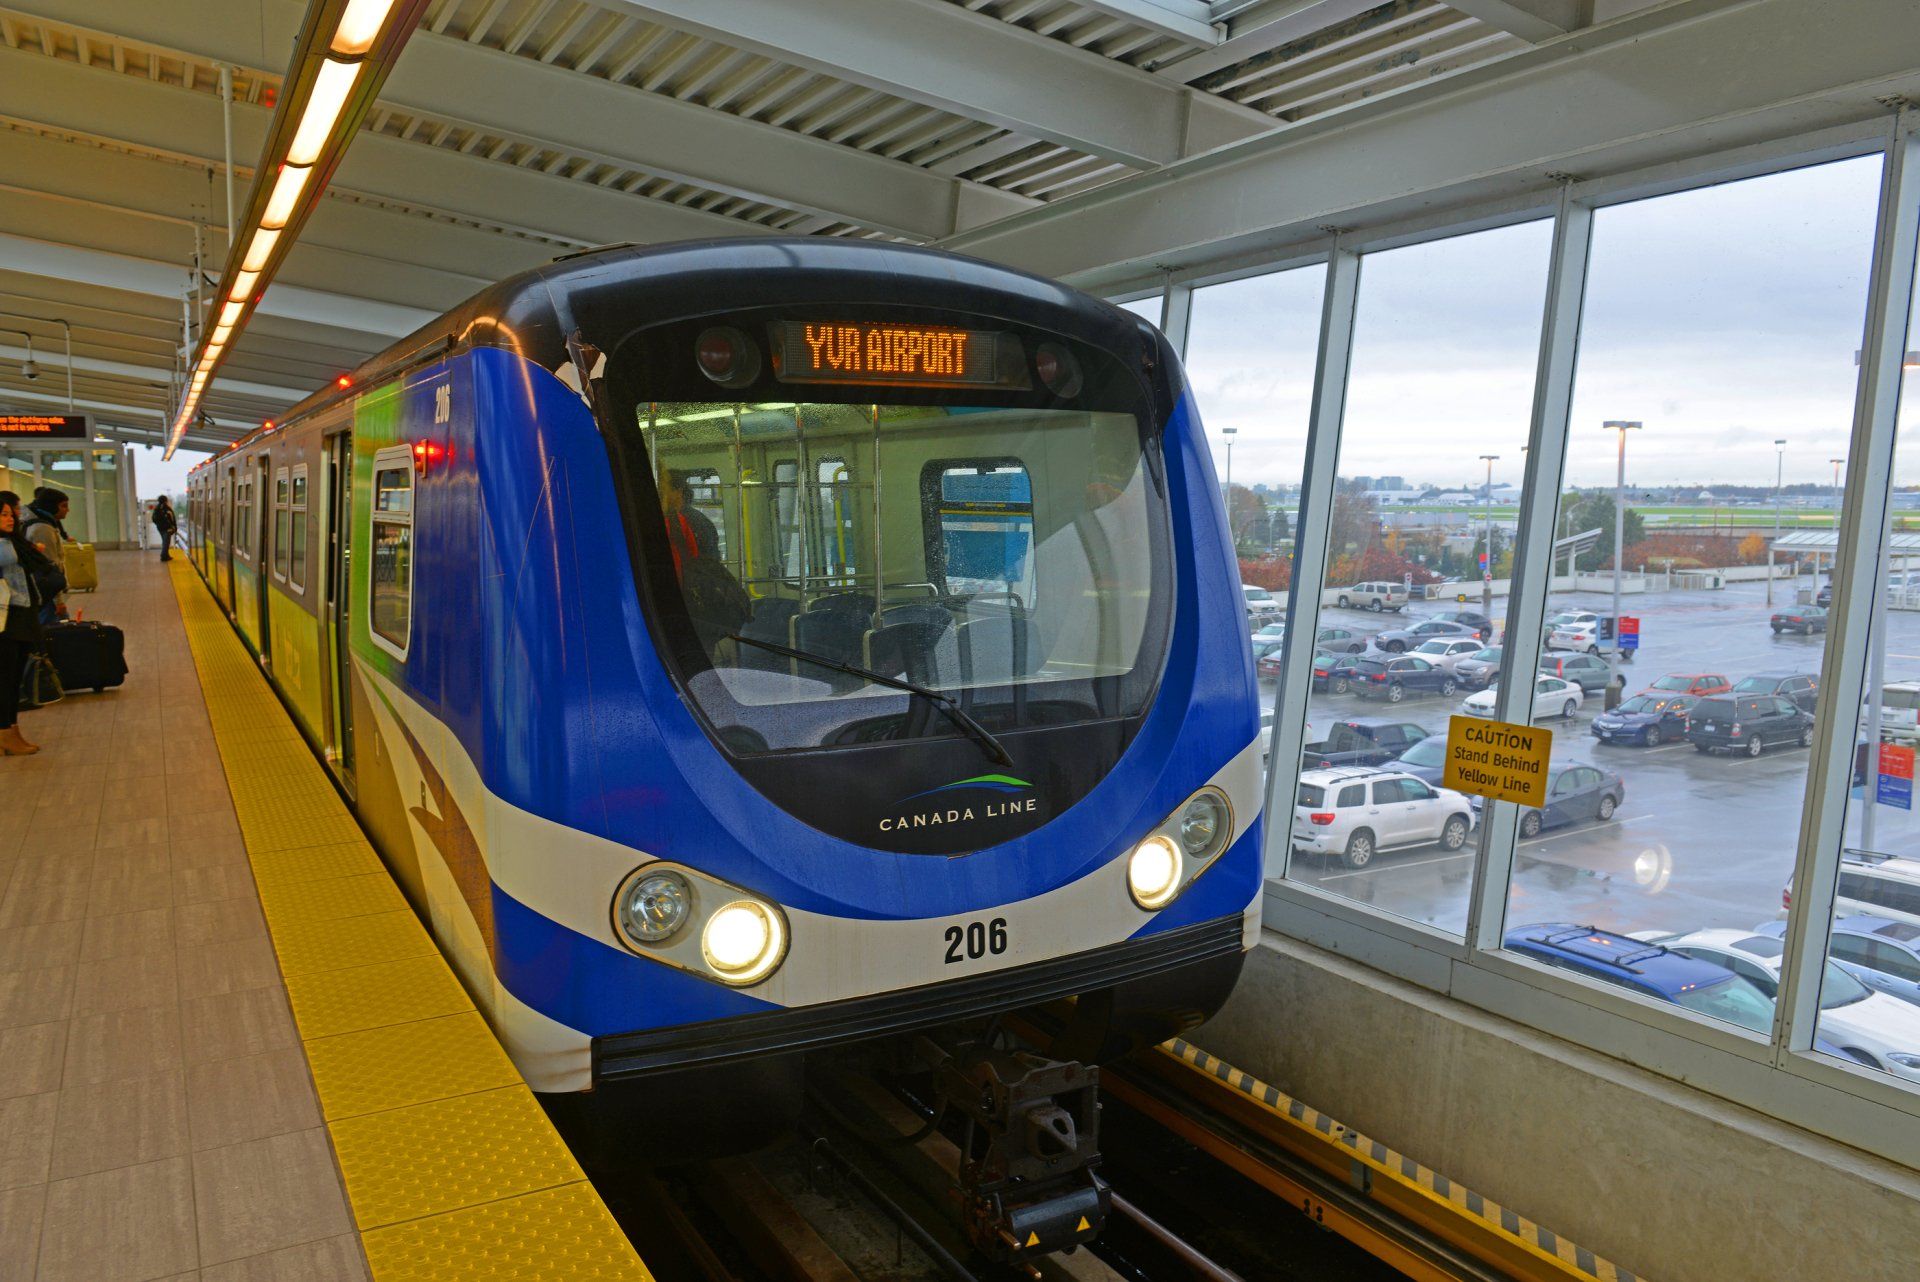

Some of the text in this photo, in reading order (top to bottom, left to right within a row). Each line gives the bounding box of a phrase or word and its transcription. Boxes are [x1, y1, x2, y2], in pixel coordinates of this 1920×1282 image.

[805, 325, 967, 374] YVR AIRPORT
[1465, 727, 1533, 752] CAUTION
[1454, 746, 1540, 774] Stand Behind
[1458, 766, 1531, 793] Yellow Line
[879, 798, 1037, 831] CANADA LINE
[944, 917, 1007, 965] 206
